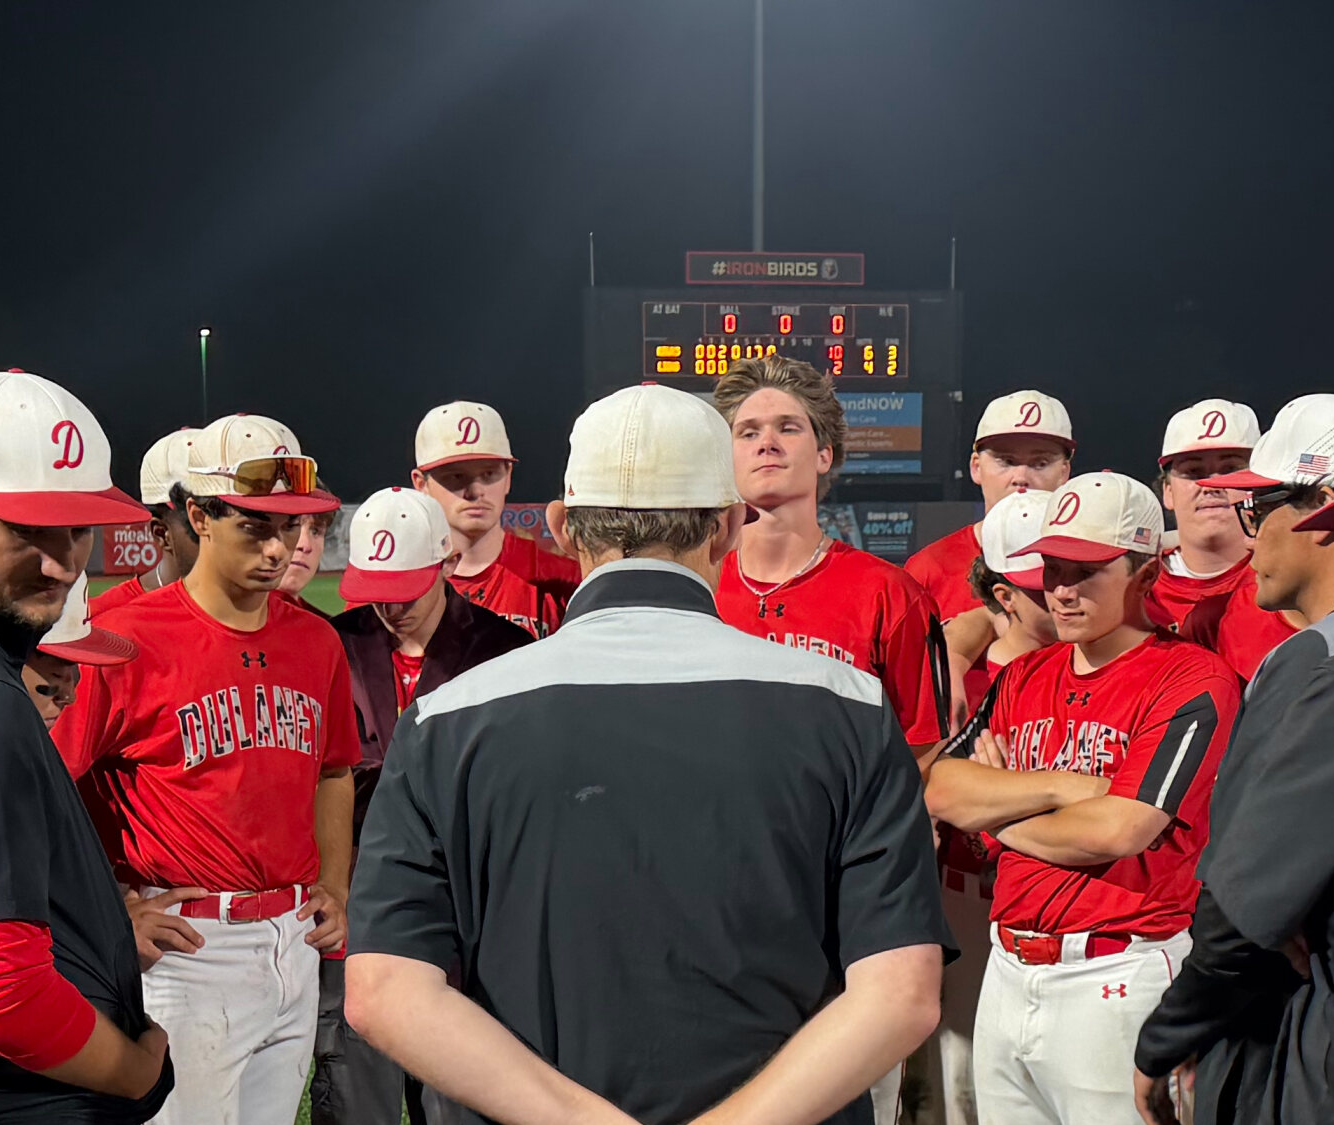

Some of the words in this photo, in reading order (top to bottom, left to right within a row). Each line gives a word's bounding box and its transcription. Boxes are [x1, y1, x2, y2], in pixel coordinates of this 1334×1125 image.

[712, 260, 818, 277] #IRONBIRDS
[725, 314, 737, 333] 0
[779, 314, 792, 334] 0
[832, 315, 844, 334] 0
[864, 345, 874, 360] 6
[888, 345, 898, 360] 3
[833, 361, 843, 375] 2
[863, 361, 874, 375] 4
[887, 361, 897, 375] 2
[1014, 401, 1041, 427] D
[1197, 410, 1227, 440] D
[455, 416, 481, 446] D
[51, 419, 84, 469] D
[1049, 491, 1081, 526] D
[894, 520, 914, 535] off
[114, 545, 157, 567] 2GO
[368, 529, 395, 562] D
[175, 684, 322, 771] DULANEY
